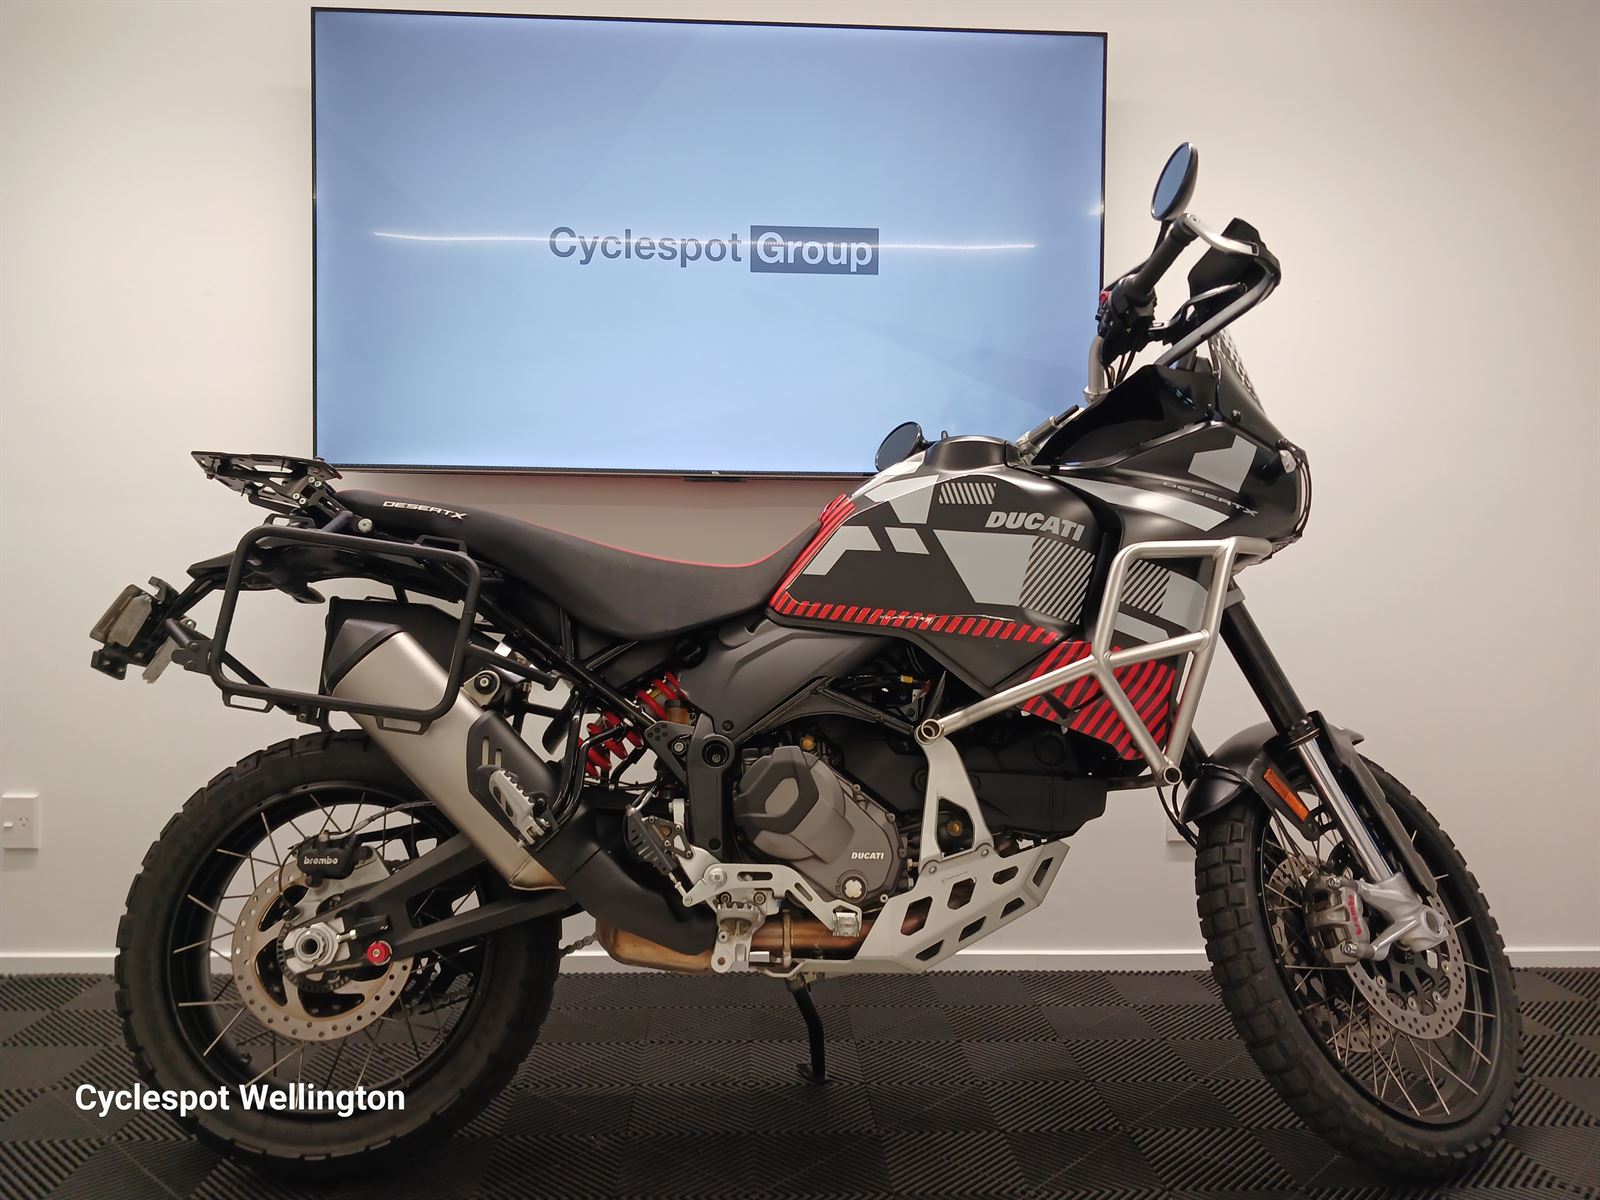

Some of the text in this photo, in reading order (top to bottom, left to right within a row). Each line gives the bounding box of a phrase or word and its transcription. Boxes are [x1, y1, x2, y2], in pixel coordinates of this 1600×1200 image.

[549, 226, 874, 272] Cyclespot Group
[984, 511, 1086, 542] DUCATI
[303, 856, 339, 865] brembo
[851, 851, 885, 860] DUCATI
